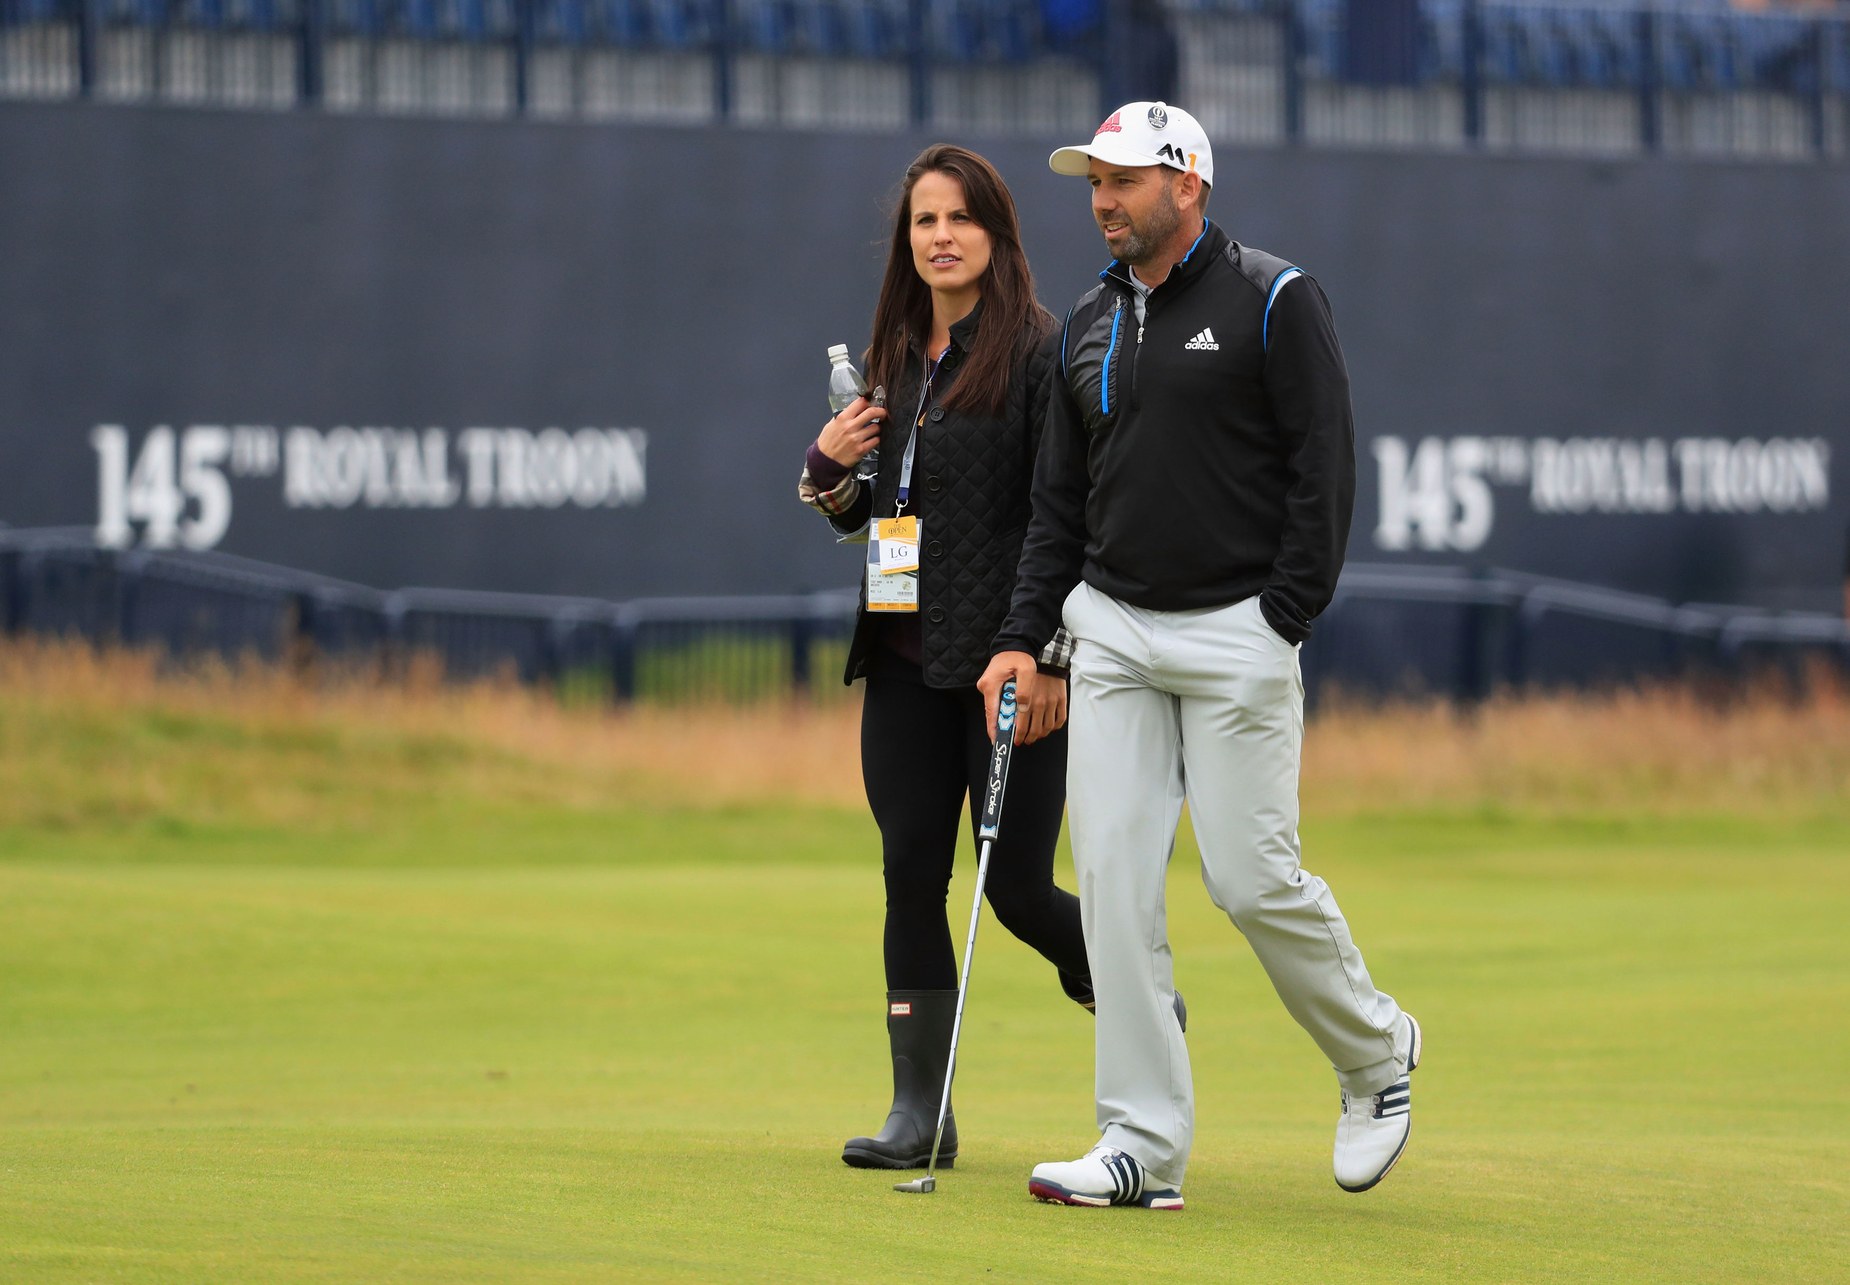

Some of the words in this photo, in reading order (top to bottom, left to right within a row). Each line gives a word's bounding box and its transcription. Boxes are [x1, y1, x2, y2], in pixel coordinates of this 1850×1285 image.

[1185, 342, 1219, 351] adidas
[285, 427, 458, 507] ROYAL
[461, 427, 646, 507] TROON
[1531, 437, 1673, 512] ROYAL
[1677, 438, 1831, 513] TROON
[890, 546, 908, 558] LG
[995, 741, 1006, 778] Super
[988, 777, 1001, 815] Stroke
